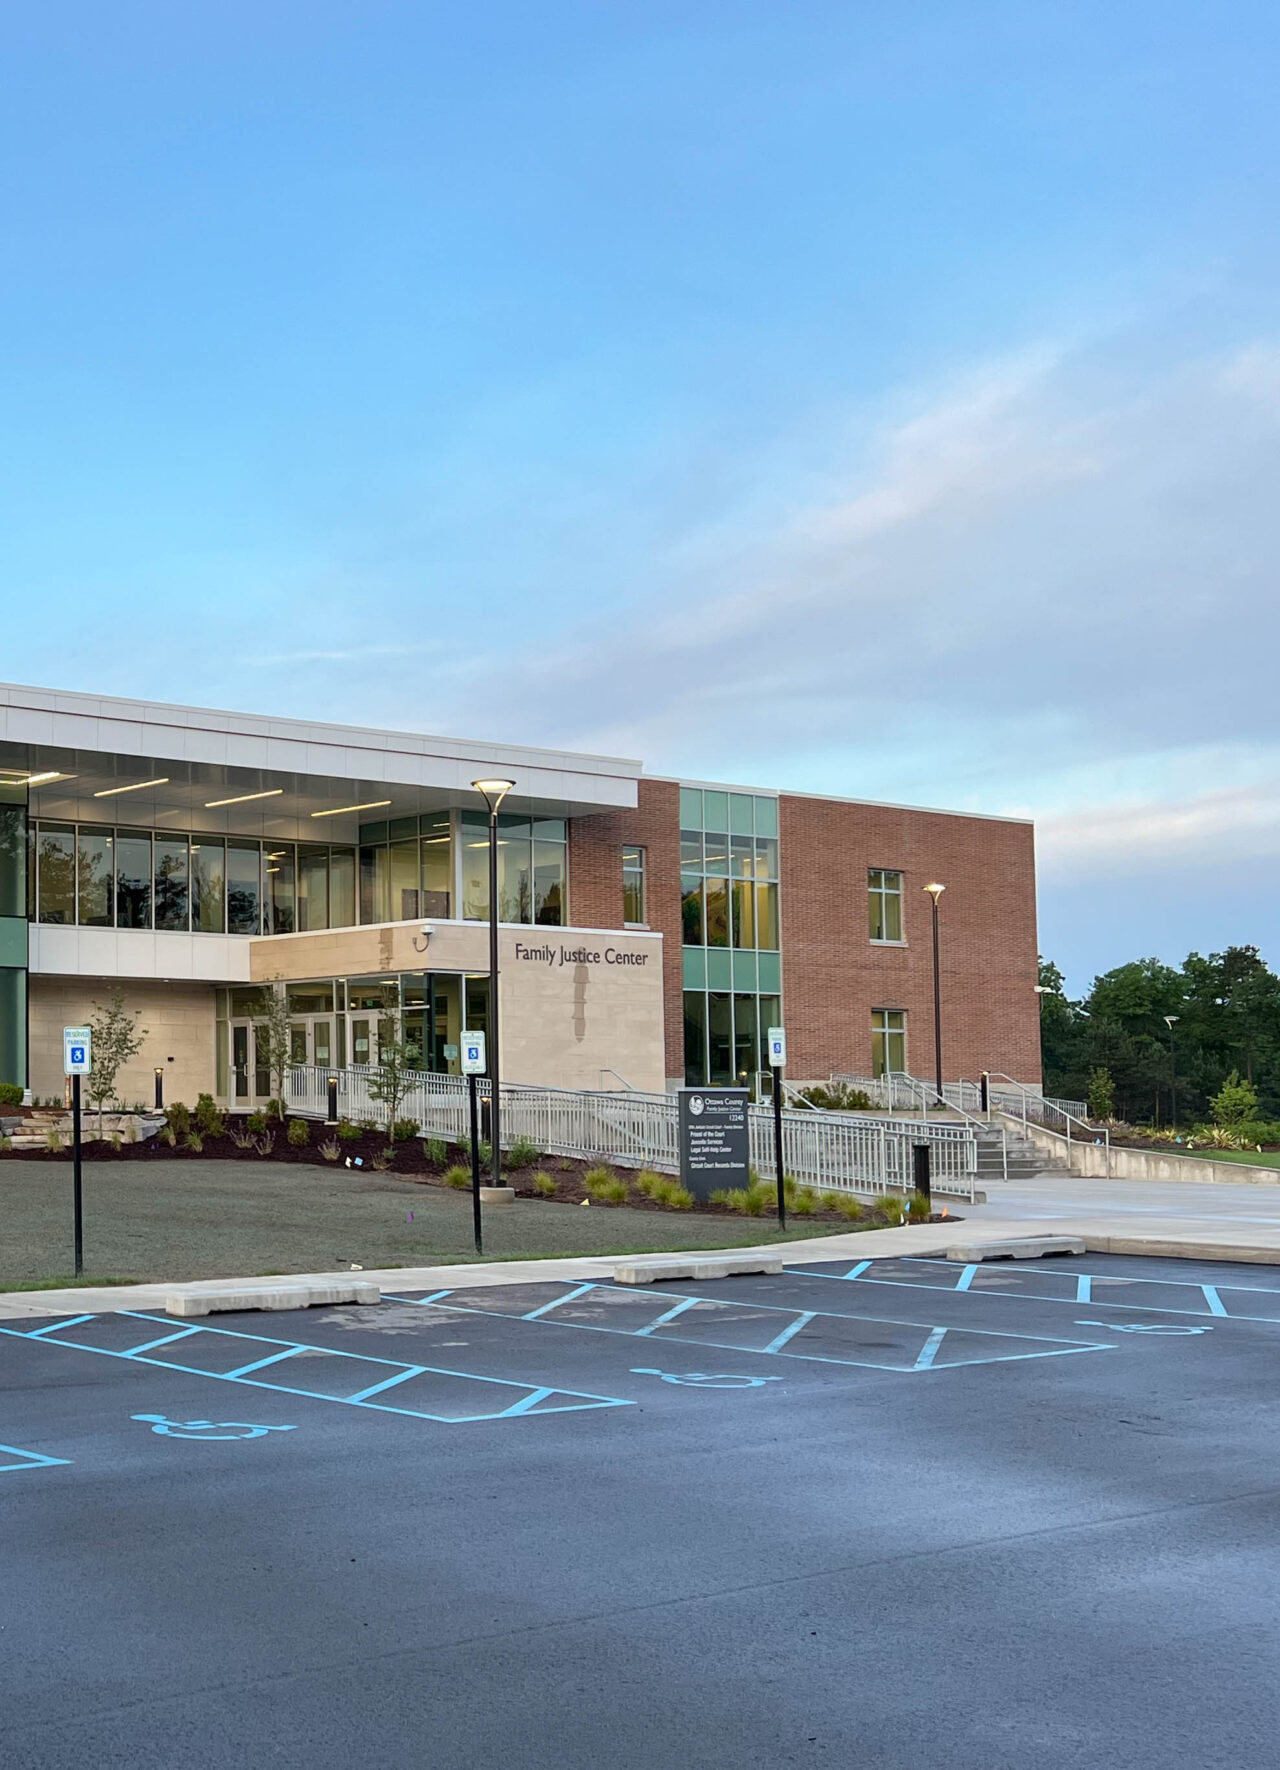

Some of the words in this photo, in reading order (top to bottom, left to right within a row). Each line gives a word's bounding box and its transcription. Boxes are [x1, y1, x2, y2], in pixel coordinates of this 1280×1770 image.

[515, 943, 556, 966] Family
[559, 945, 601, 967] Justice
[604, 948, 649, 966] Center
[725, 1098, 743, 1106] County
